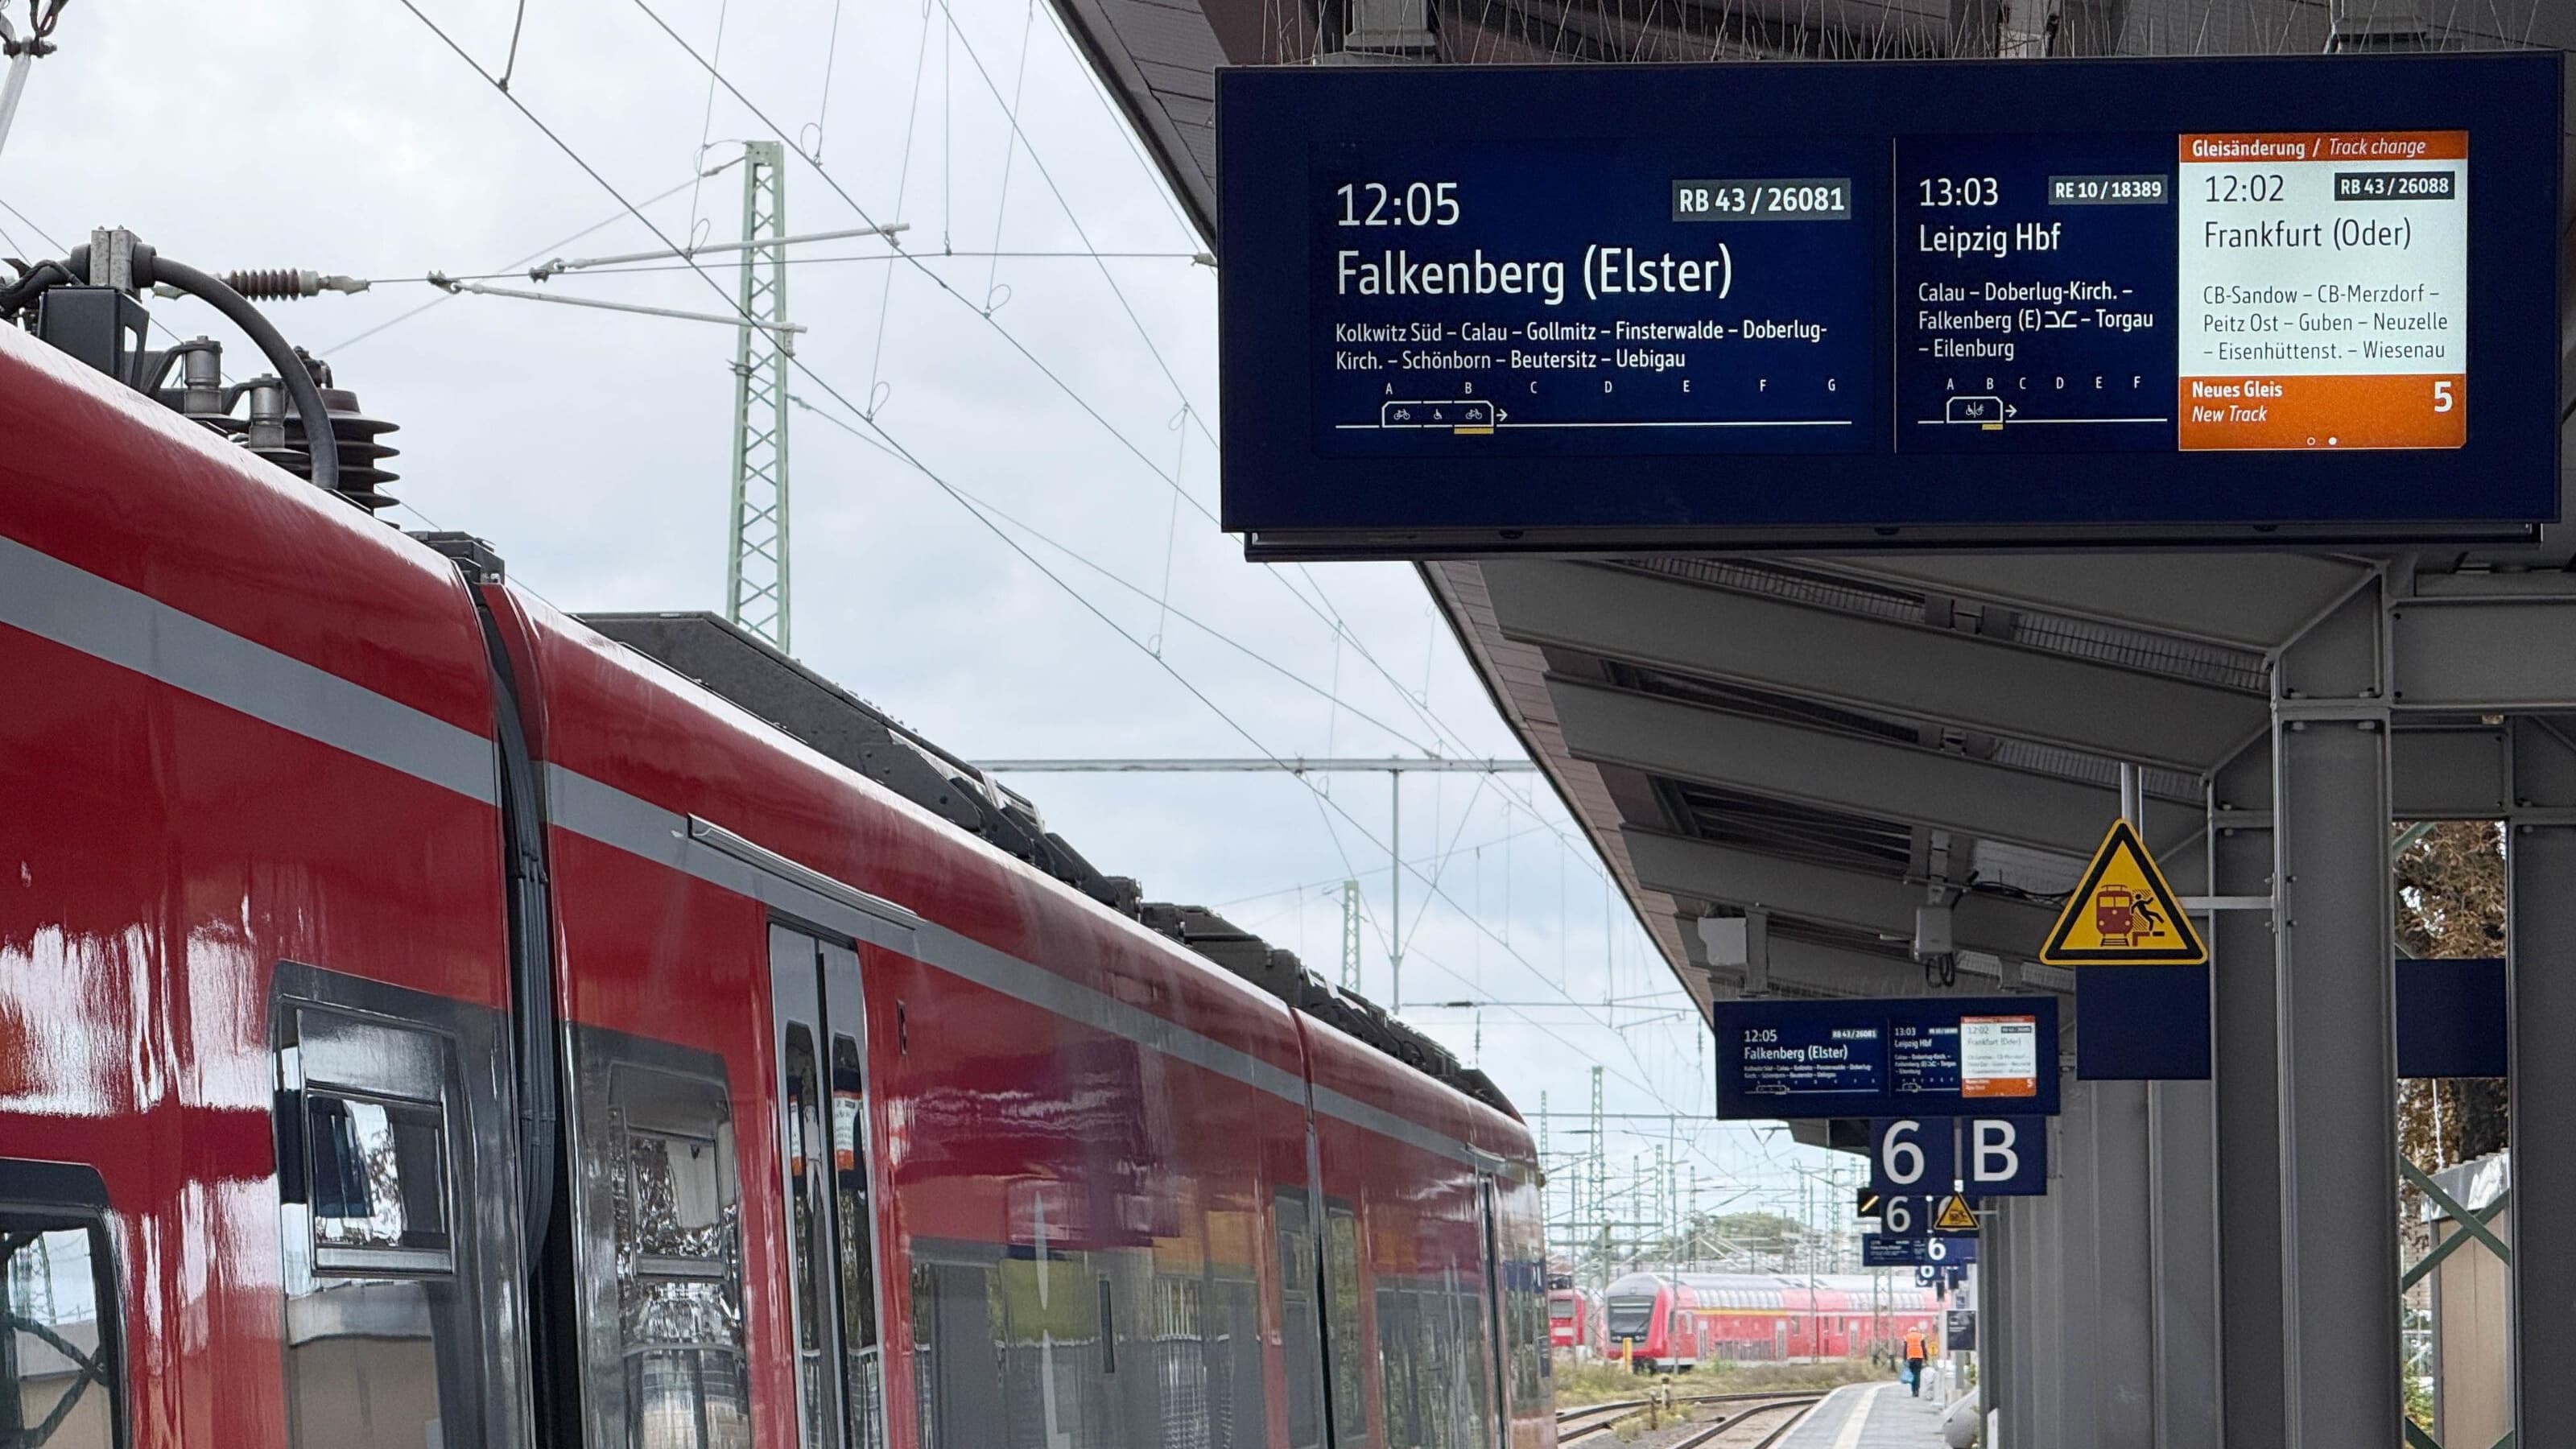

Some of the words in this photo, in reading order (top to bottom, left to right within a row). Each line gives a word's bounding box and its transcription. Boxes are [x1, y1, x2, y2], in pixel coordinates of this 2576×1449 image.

[2192, 139, 2306, 160] Gleisänderung
[2330, 138, 2368, 155] Track
[2371, 138, 2426, 159] change
[1920, 177, 1999, 206] 13:03
[2055, 182, 2074, 198] RE
[2078, 182, 2098, 198] 10
[2112, 181, 2161, 198] 18389
[2206, 174, 2284, 202] 12:02
[2341, 179, 2361, 195] RB
[2363, 178, 2384, 194] 43
[2398, 177, 2449, 194] 26088
[1337, 182, 1459, 226] 12:05
[1680, 188, 1709, 213] RB
[1715, 188, 1746, 213] 43
[1768, 187, 1845, 212] 26081
[1920, 224, 2007, 258] Leipzig
[2017, 222, 2062, 251] Hbf
[2206, 220, 2322, 248] Frankfurt
[2334, 217, 2411, 251] (Oder)
[1339, 249, 1564, 306] Falkenberg
[1583, 242, 1732, 300] (Elster)
[1918, 282, 1965, 302] Calau
[1985, 280, 2117, 305] Doberlug-Kirch.
[2203, 285, 2297, 304] CB-Sandow
[2318, 283, 2425, 303] CB-Merzdorf
[1336, 323, 1407, 342] Kolkwitz
[1410, 322, 1442, 342] Süd
[1462, 322, 1507, 341] Calau
[1526, 321, 1596, 341] Gollmitz
[1616, 320, 1724, 340] Finsterwalde
[1744, 319, 1827, 343] Doberlug-
[1919, 310, 2012, 334] Falkenberg
[2018, 308, 2041, 332] (E)
[2095, 308, 2153, 332] Torgau
[2204, 314, 2245, 332] Peitz
[2250, 313, 2278, 332] Ost
[2299, 312, 2352, 332] Guben
[2374, 312, 2448, 331] Neuzelle
[1336, 350, 1383, 370] Kirch.
[1402, 350, 1491, 369] Schönborn
[1511, 349, 1597, 369] Beutersitz
[1616, 348, 1686, 372] Uebigau
[1934, 338, 2014, 361] Eilenburg
[2219, 341, 2343, 361] Eisenhüttenst.
[2363, 341, 2445, 358] Wiesenau
[1385, 382, 1393, 395] A
[1464, 382, 1472, 394] B
[1530, 381, 1538, 394] C
[1604, 380, 1612, 394] D
[1683, 380, 1690, 393] E
[1760, 379, 1767, 392] F
[1827, 378, 1836, 392] G
[1946, 378, 1955, 390] A
[1986, 377, 1994, 390] B
[2019, 377, 2026, 390] C
[2056, 376, 2064, 390] D
[2095, 376, 2103, 389] E
[2134, 375, 2141, 389] F
[2192, 381, 2240, 398] Neues
[2244, 380, 2283, 398] Gleis
[2434, 381, 2453, 413] 5
[2192, 406, 2225, 423] New
[2229, 405, 2268, 422] Track
[1744, 1030, 1777, 1042] 12:05
[1894, 1027, 1916, 1037] 13:03
[1744, 1046, 1805, 1062] Falkenberg
[1807, 1044, 1848, 1061] (Elster)
[1882, 1120, 1925, 1185] 6
[1973, 1119, 2018, 1182] B
[1886, 1195, 1911, 1232] 6
[1928, 1237, 1946, 1261] 6
